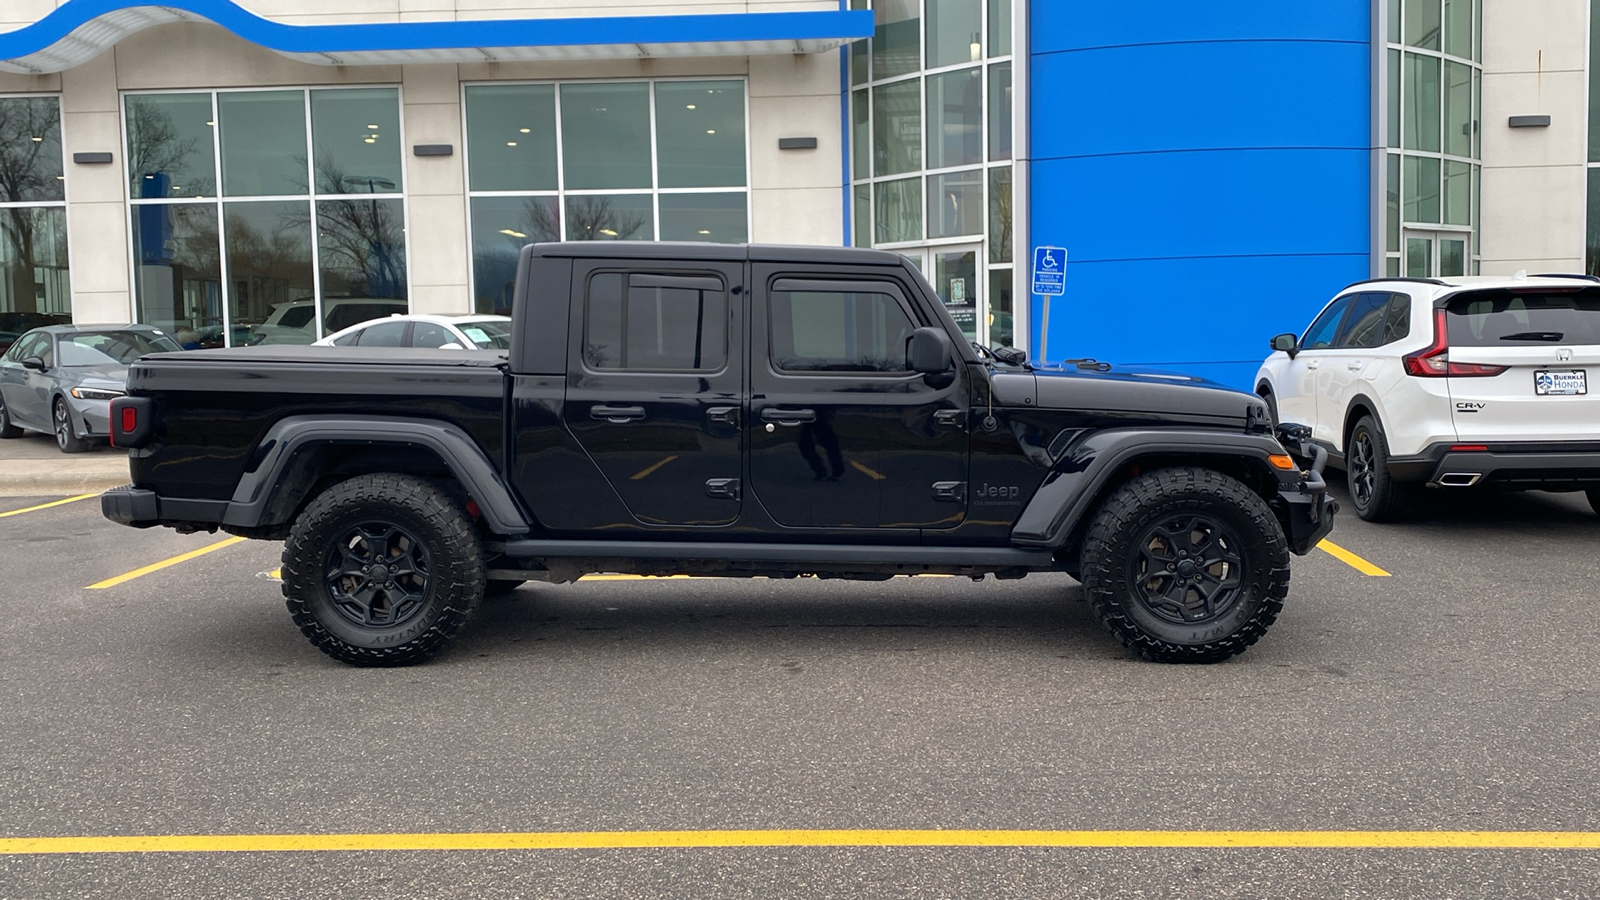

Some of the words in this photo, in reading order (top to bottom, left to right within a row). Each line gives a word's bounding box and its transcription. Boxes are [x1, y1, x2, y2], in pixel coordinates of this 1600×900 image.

[1554, 380, 1585, 389] HONDA
[976, 483, 1019, 499] Jeep
[1128, 500, 1214, 538] COUNTRY
[370, 594, 443, 645] COUNTRY
